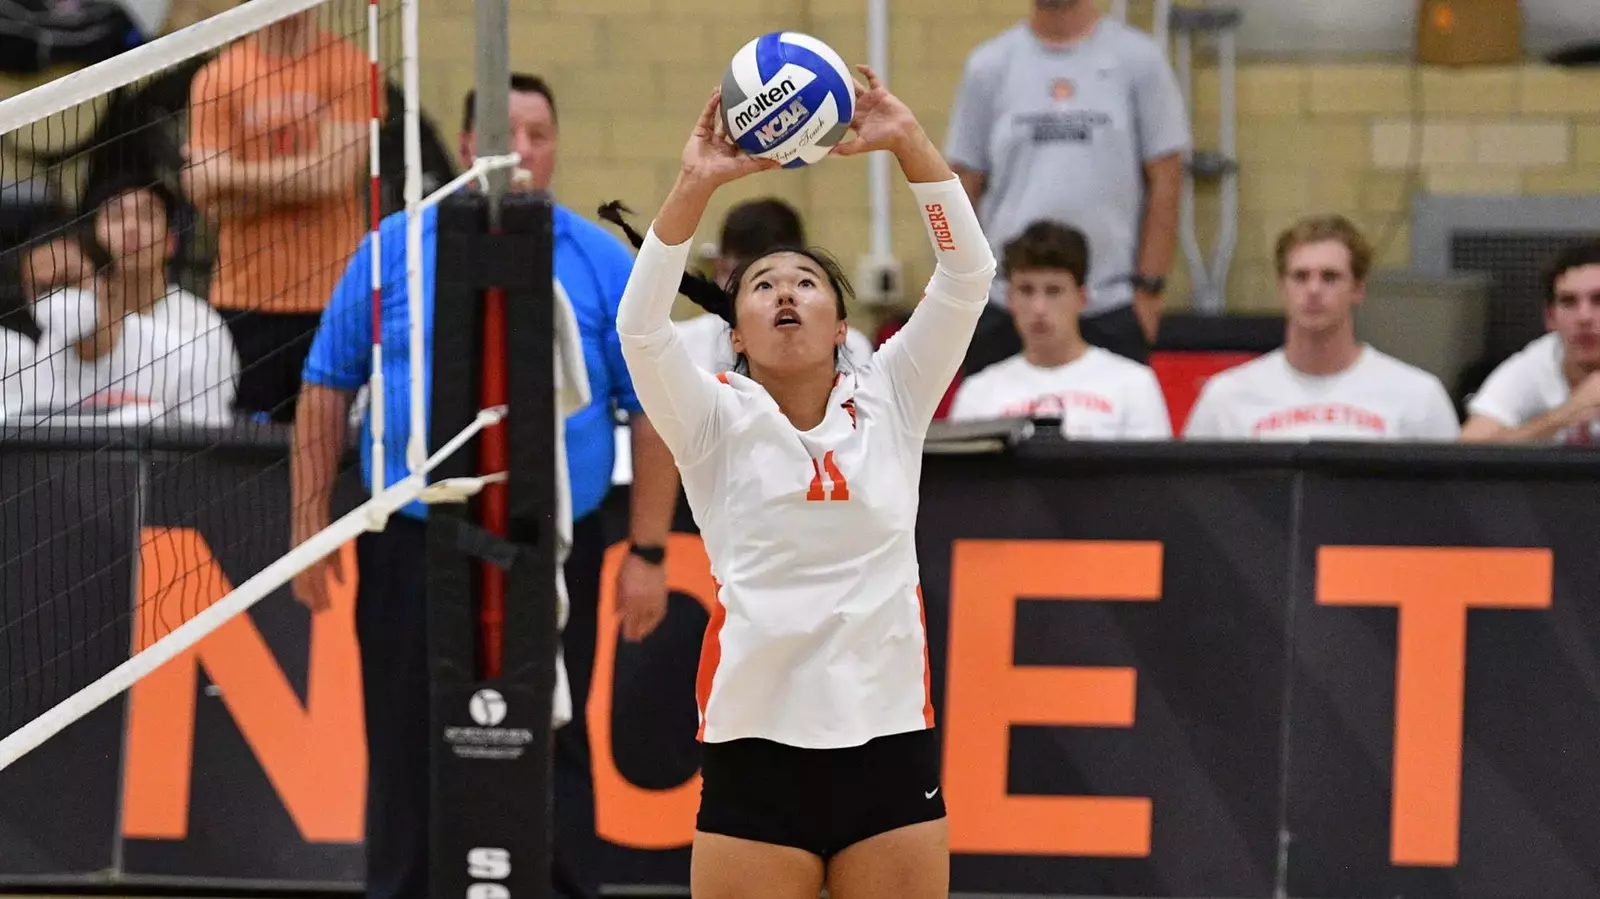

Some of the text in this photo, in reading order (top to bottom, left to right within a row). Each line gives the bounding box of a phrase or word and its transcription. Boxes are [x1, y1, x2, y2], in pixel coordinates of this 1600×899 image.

[735, 79, 796, 131] molten
[754, 100, 810, 149] NCAA
[925, 203, 956, 252] TIGERS
[806, 450, 850, 501] 11
